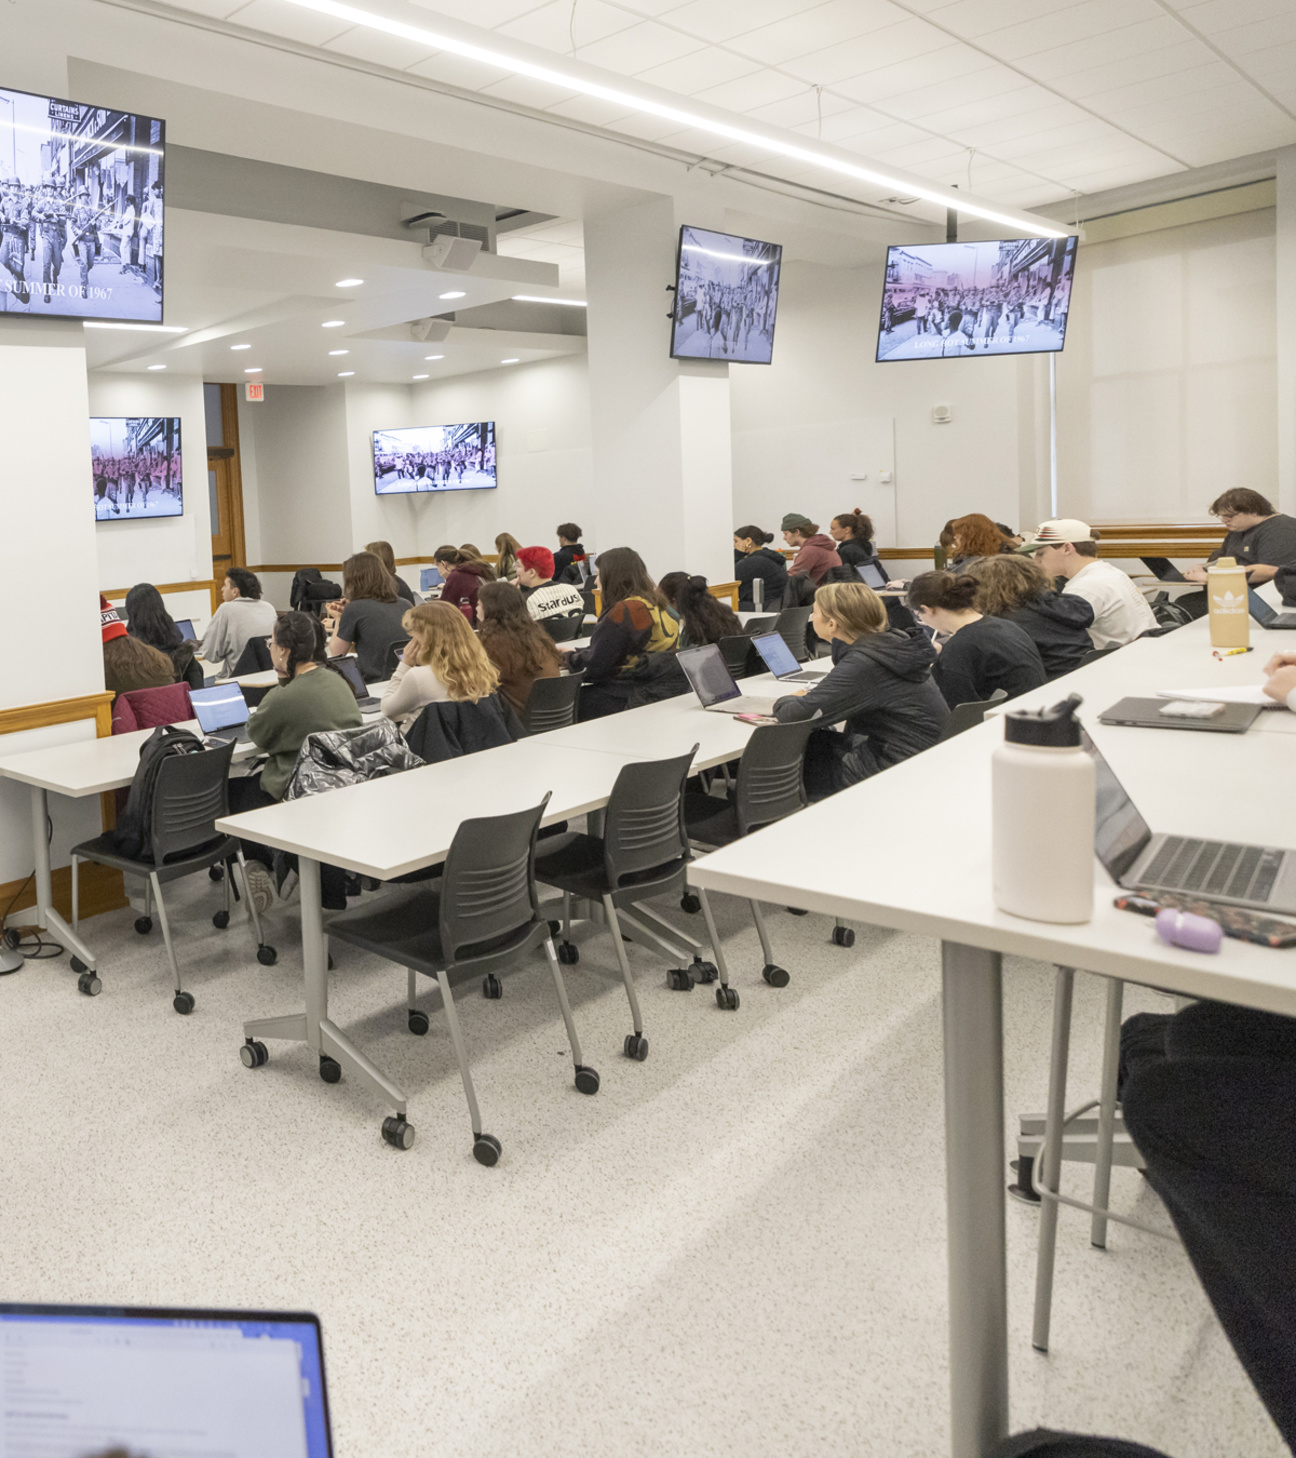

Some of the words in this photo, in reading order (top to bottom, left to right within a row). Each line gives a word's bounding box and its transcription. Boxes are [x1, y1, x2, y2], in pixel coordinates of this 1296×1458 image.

[5, 281, 66, 297] SUMMER
[68, 286, 86, 298] OF
[89, 287, 113, 300] 1967
[249, 384, 262, 399] EXIT
